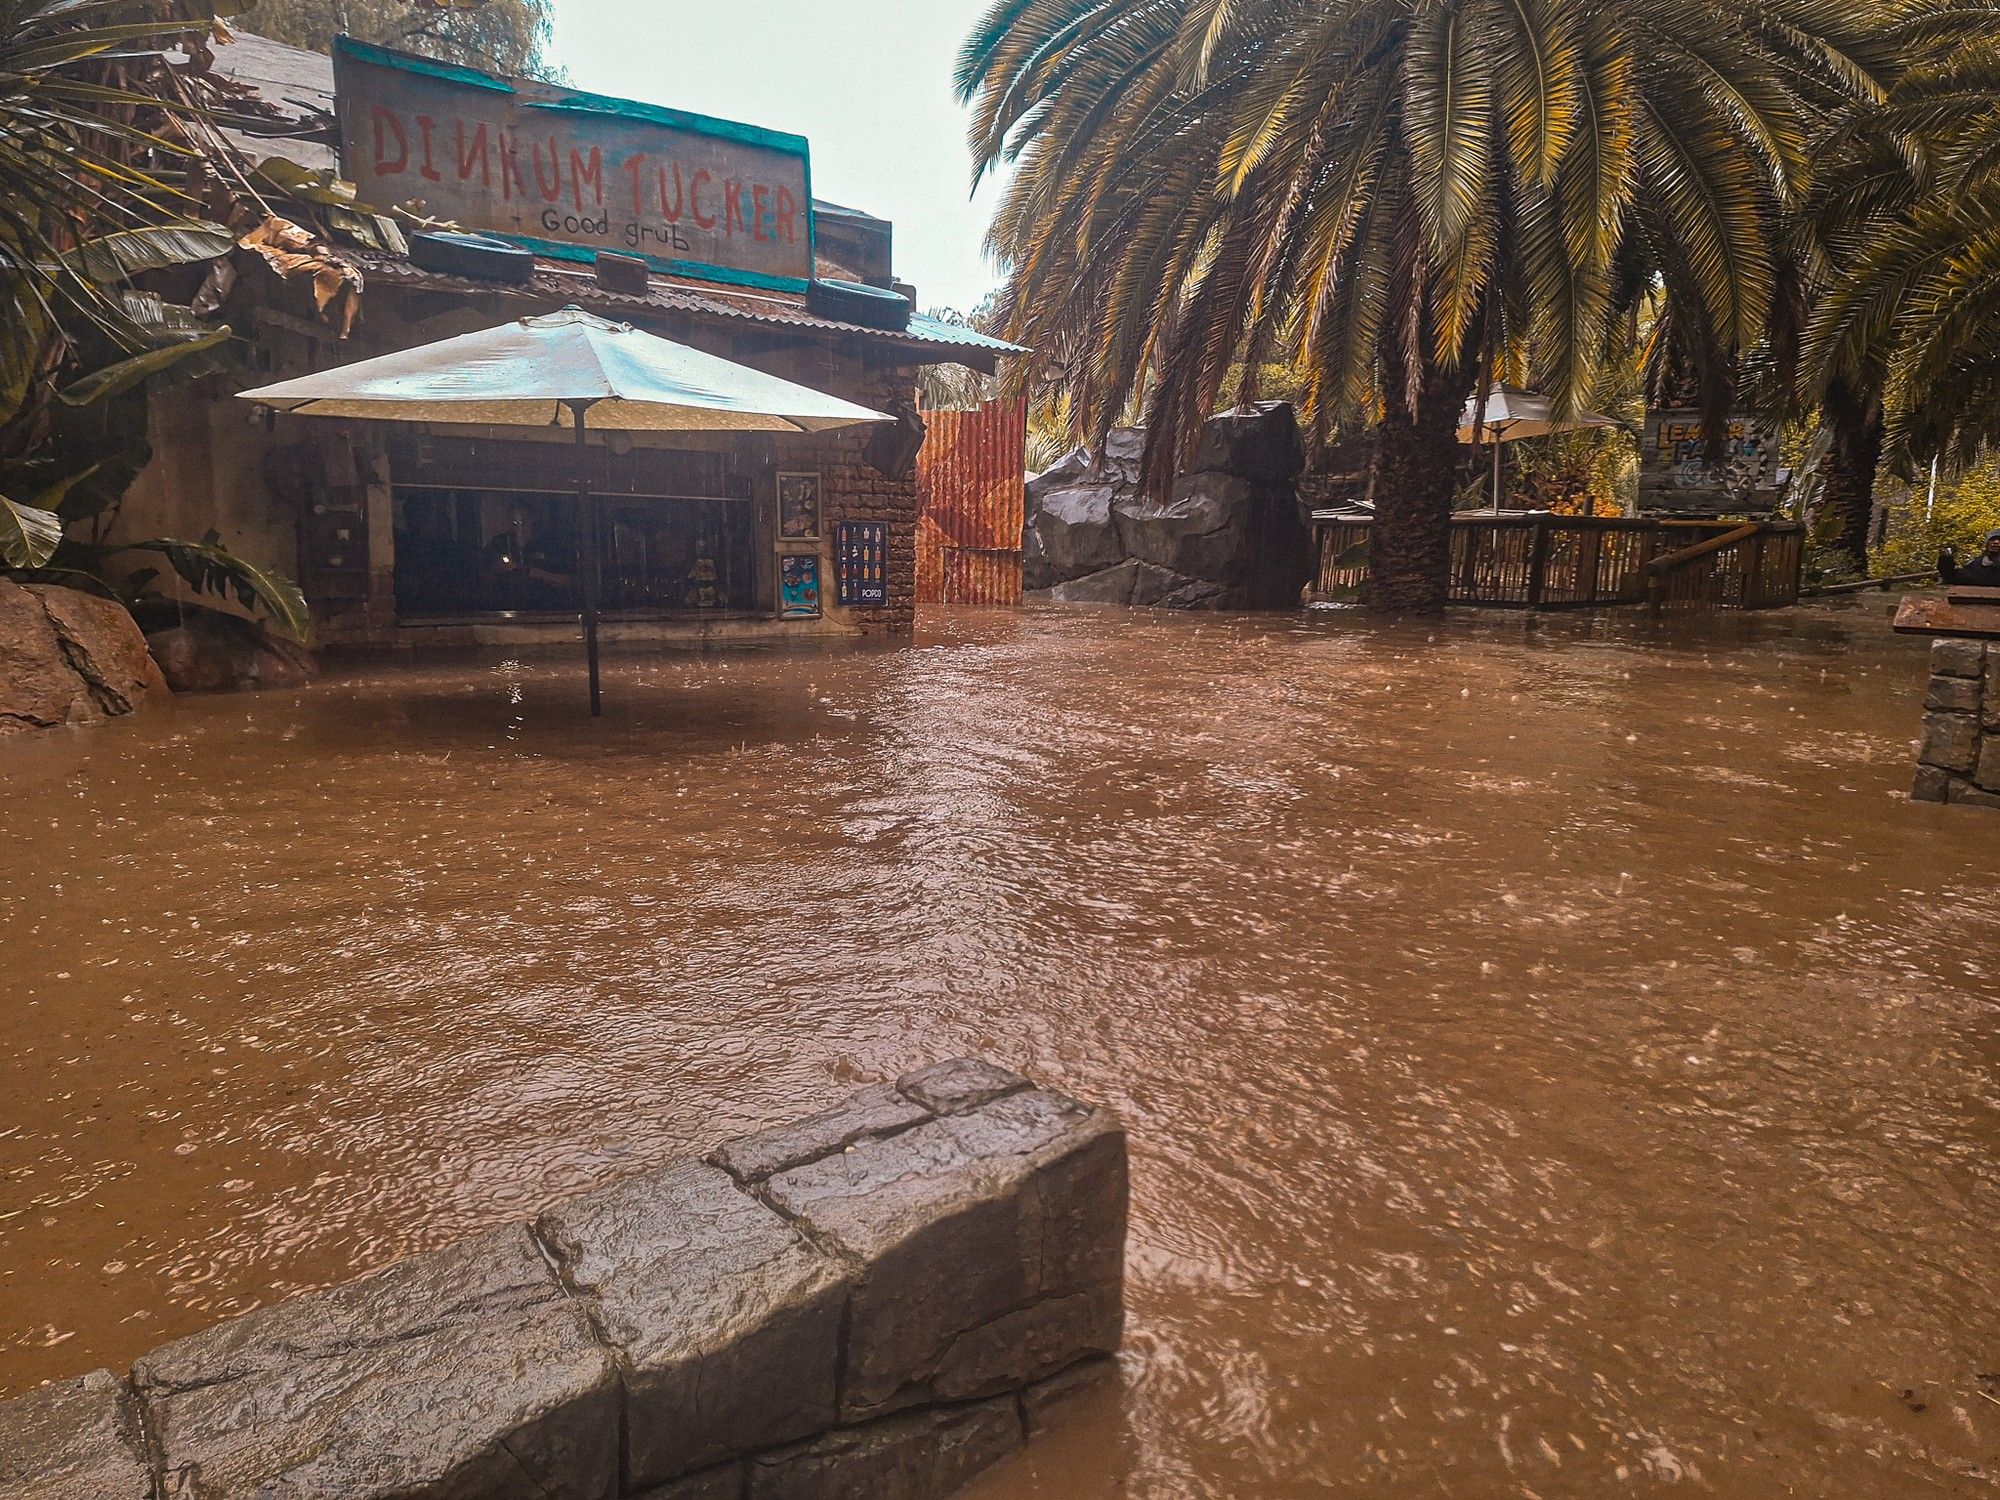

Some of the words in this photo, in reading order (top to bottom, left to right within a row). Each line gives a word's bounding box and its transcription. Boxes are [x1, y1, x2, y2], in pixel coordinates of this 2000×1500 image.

[372, 105, 602, 213] DINKUM
[622, 152, 796, 244] TUCKER
[541, 208, 609, 235] Good
[625, 222, 690, 251] grub
